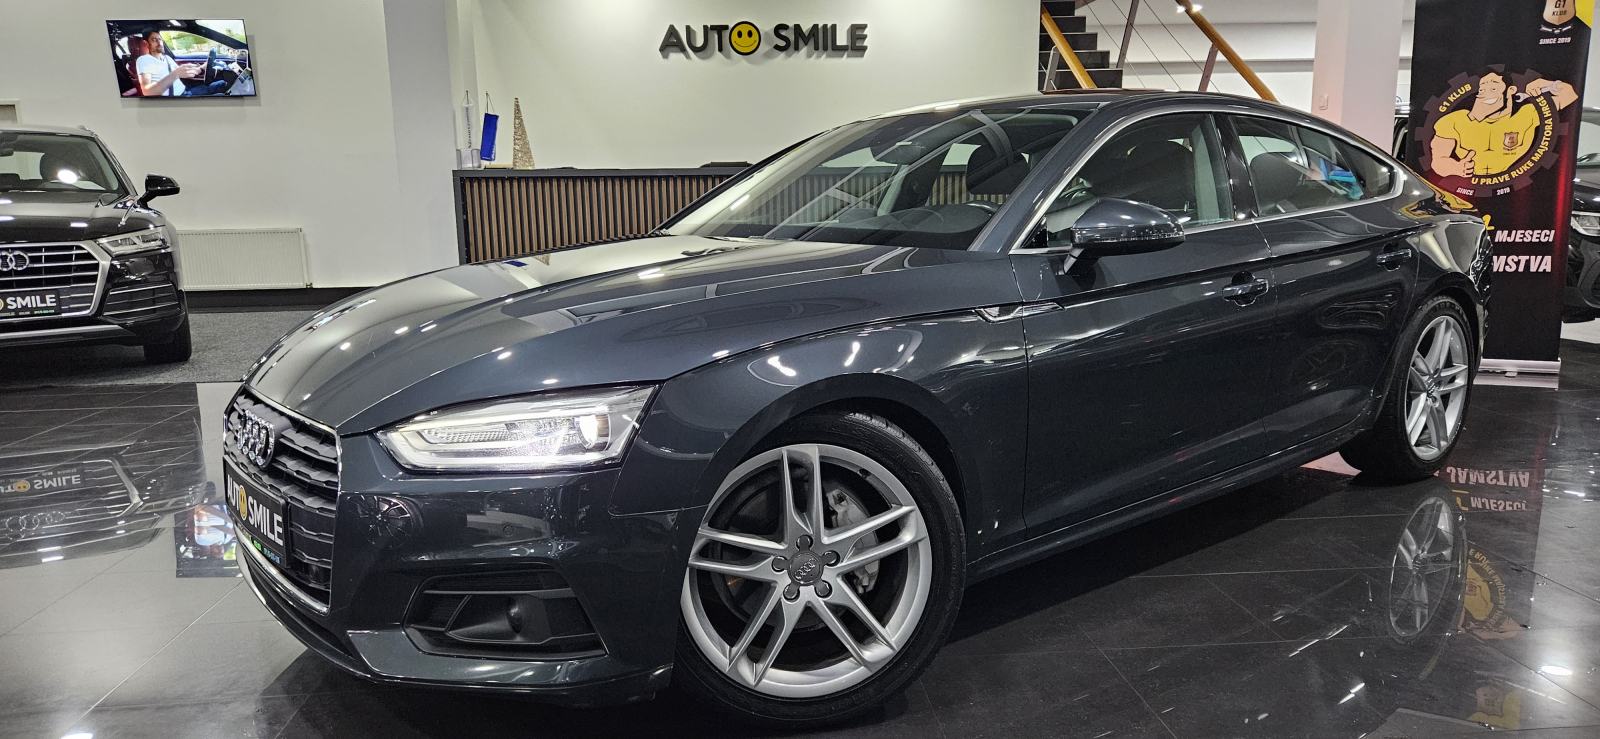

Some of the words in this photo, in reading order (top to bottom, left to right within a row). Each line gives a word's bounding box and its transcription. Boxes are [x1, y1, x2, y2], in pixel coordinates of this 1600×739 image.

[773, 23, 868, 52] SMILE
[1438, 101, 1451, 113] G1
[1448, 83, 1472, 102] KLUB
[1536, 95, 1552, 118] HRGE
[1531, 117, 1553, 162] MAJSTORA
[1510, 160, 1535, 178] RUKE
[1471, 177, 1479, 185] U
[1480, 174, 1510, 185] PRAVE
[1456, 187, 1475, 196] SINCE
[1494, 229, 1555, 243] MJESECI
[6, 294, 57, 309] SMILE
[248, 495, 284, 546] SMILE
